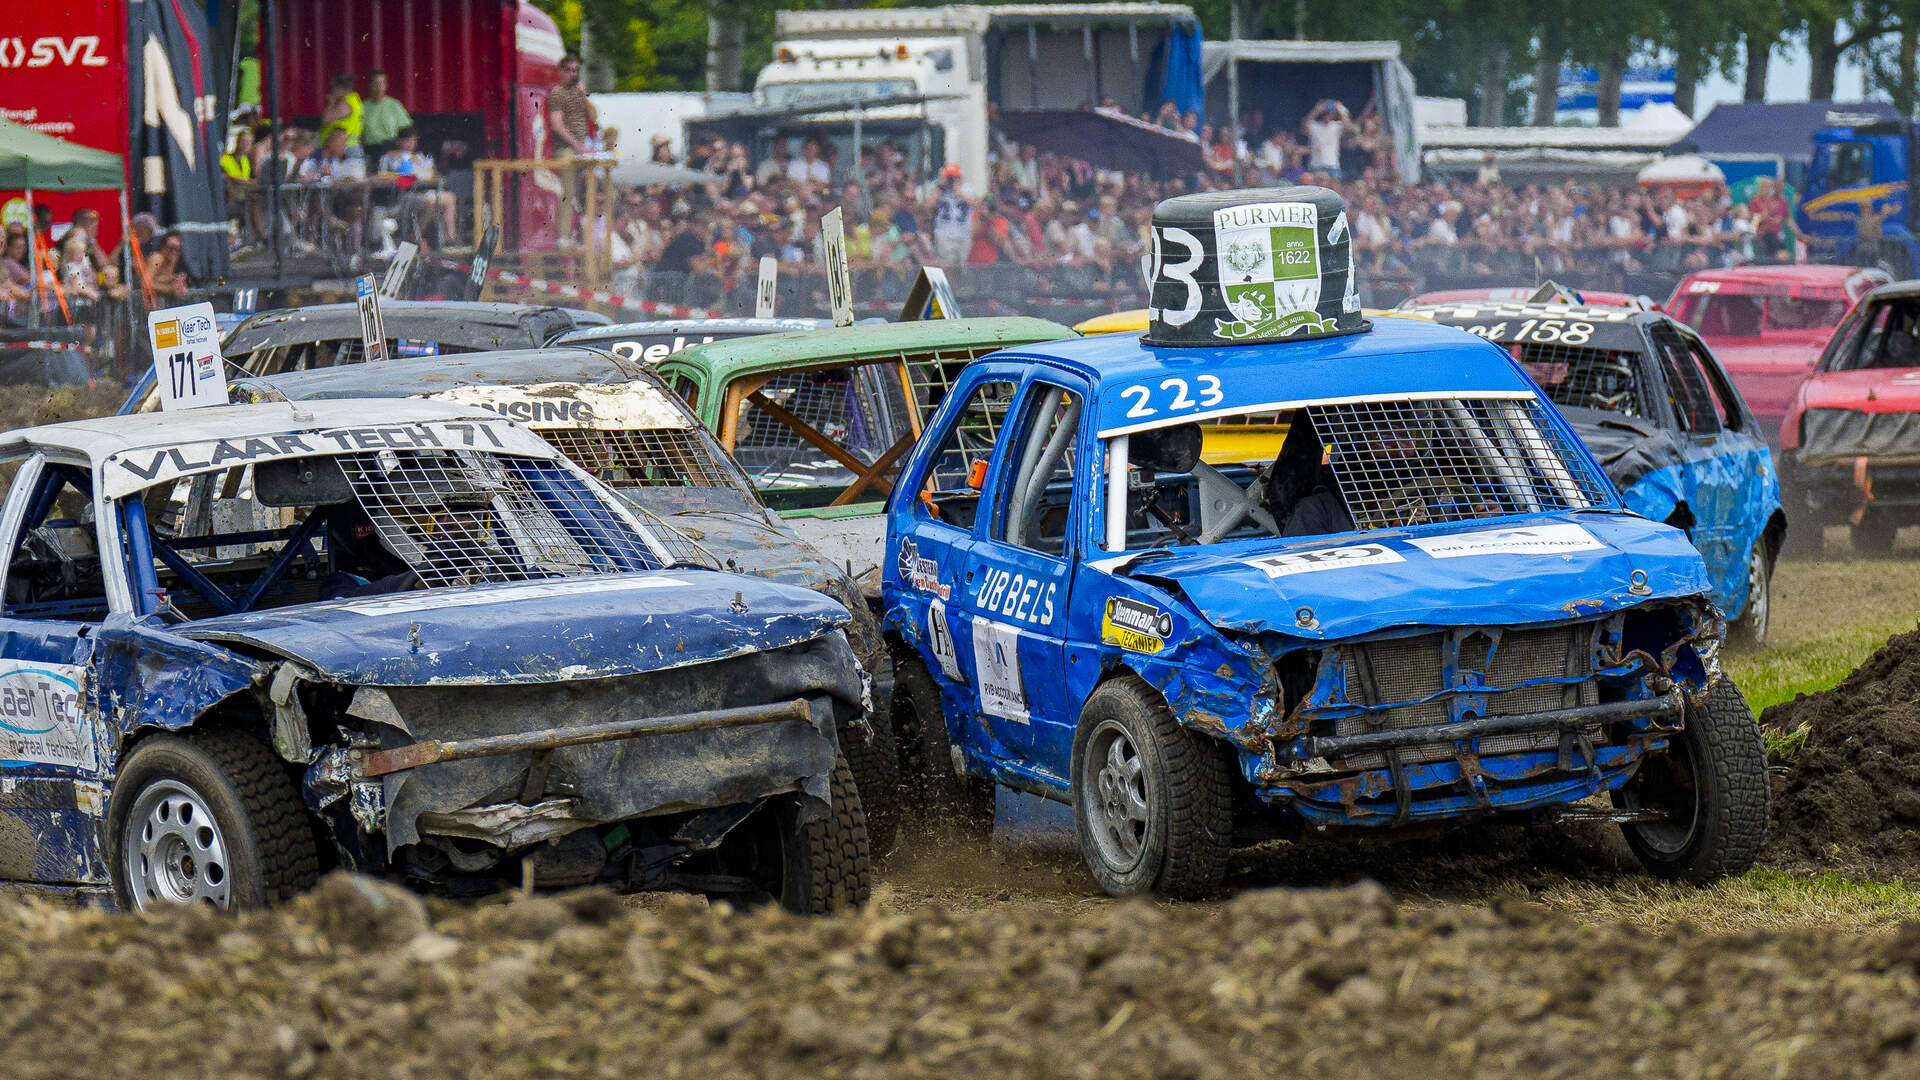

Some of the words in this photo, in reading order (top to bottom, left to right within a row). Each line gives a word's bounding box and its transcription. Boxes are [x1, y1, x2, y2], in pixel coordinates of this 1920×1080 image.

[27, 36, 108, 67] SVZ
[1219, 206, 1314, 230] PURMER
[1278, 250, 1311, 265] 1622
[1285, 240, 1304, 249] anno
[237, 288, 254, 311] 11
[1452, 322, 1508, 341] ot
[1513, 319, 1595, 345] 158
[168, 351, 196, 399] 171
[1120, 374, 1224, 418] 223
[120, 435, 316, 479] VLAAR
[323, 425, 445, 450] TECH
[443, 423, 505, 448] 71
[1469, 540, 1591, 550] ACCOUNTANCY
[976, 567, 1057, 625] UBBELS
